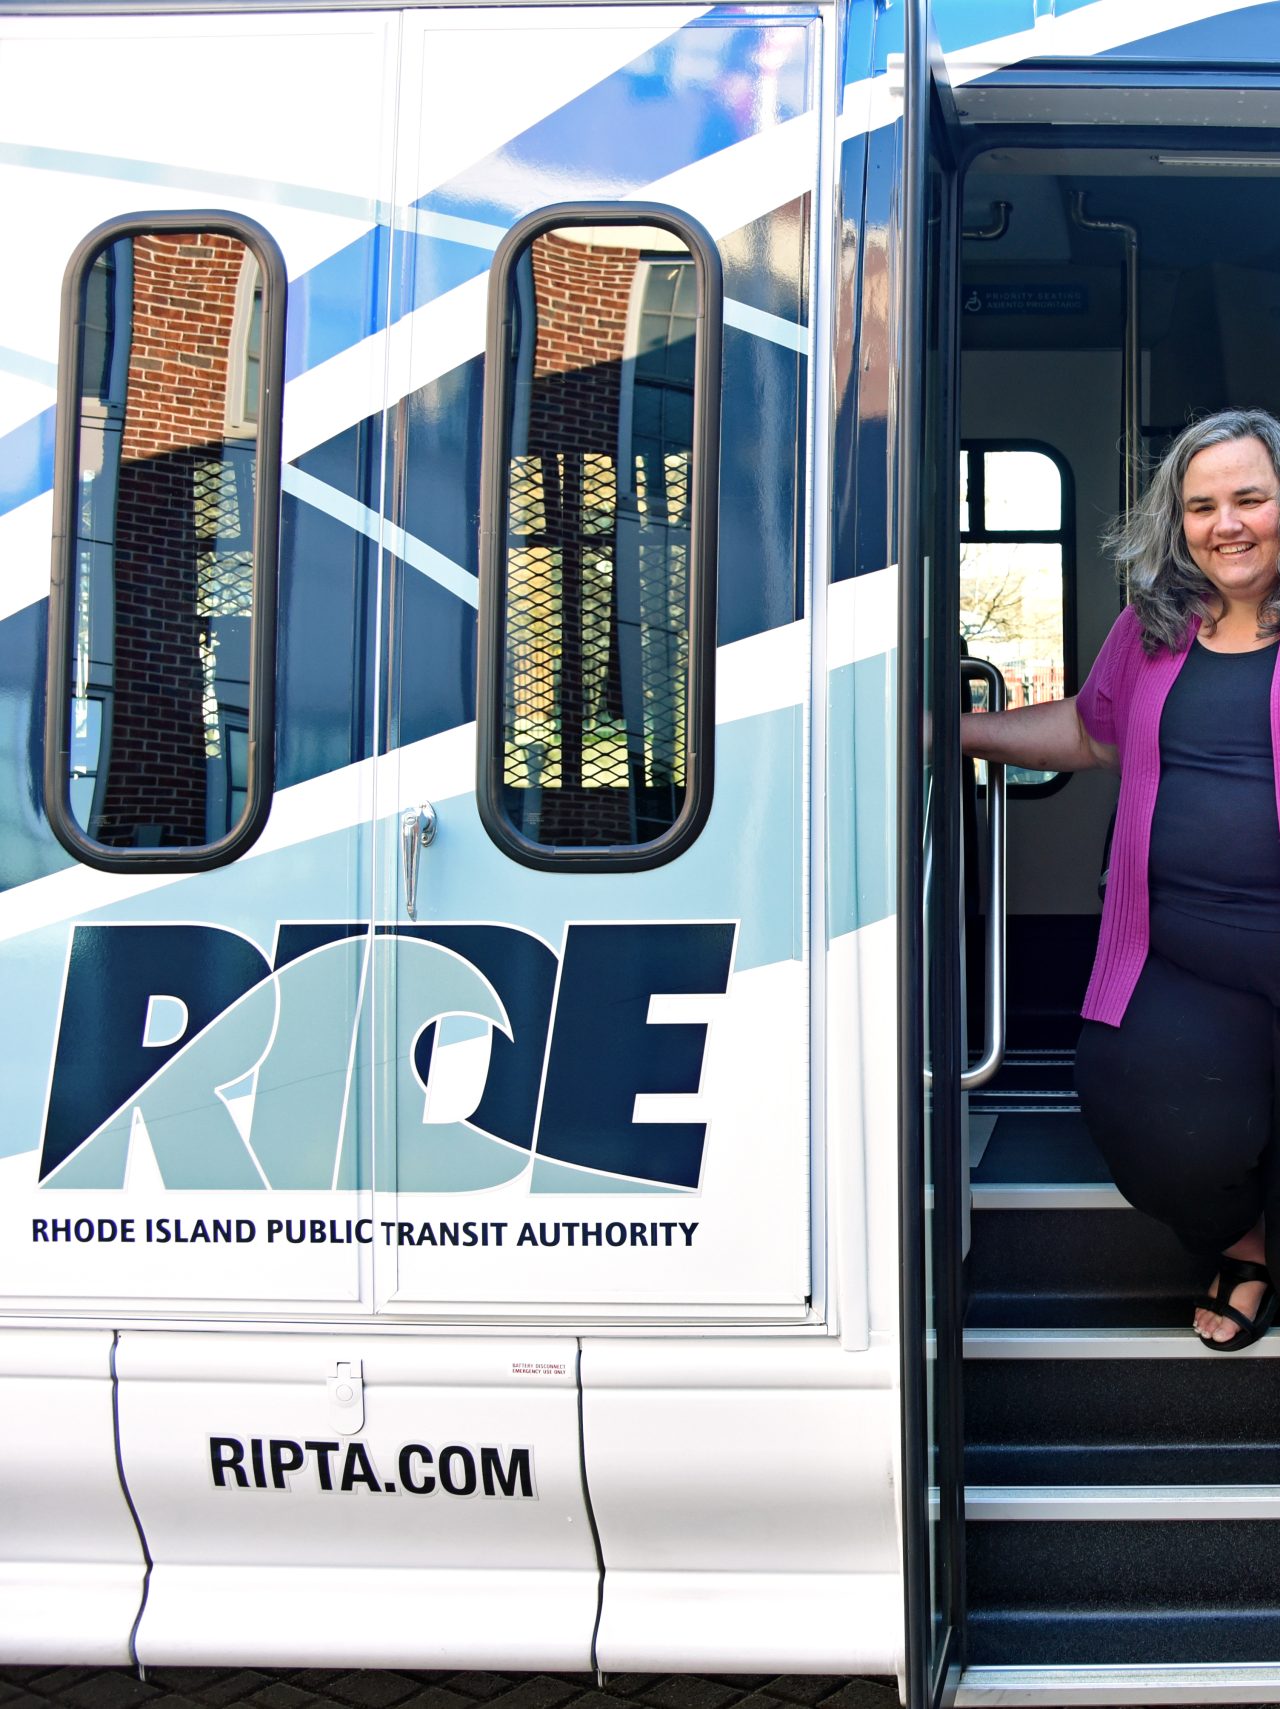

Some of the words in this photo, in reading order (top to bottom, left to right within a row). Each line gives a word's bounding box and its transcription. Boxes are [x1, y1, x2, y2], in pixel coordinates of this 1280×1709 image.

[37, 920, 741, 1197] RIDE
[33, 1219, 135, 1242] RHODE
[147, 1219, 255, 1243] ISLAND
[268, 1219, 372, 1243] PUBLIC
[381, 1222, 507, 1246] TRANSIT
[517, 1222, 699, 1246] AUTHORITY
[210, 1438, 533, 1496] RIPTA.COM
